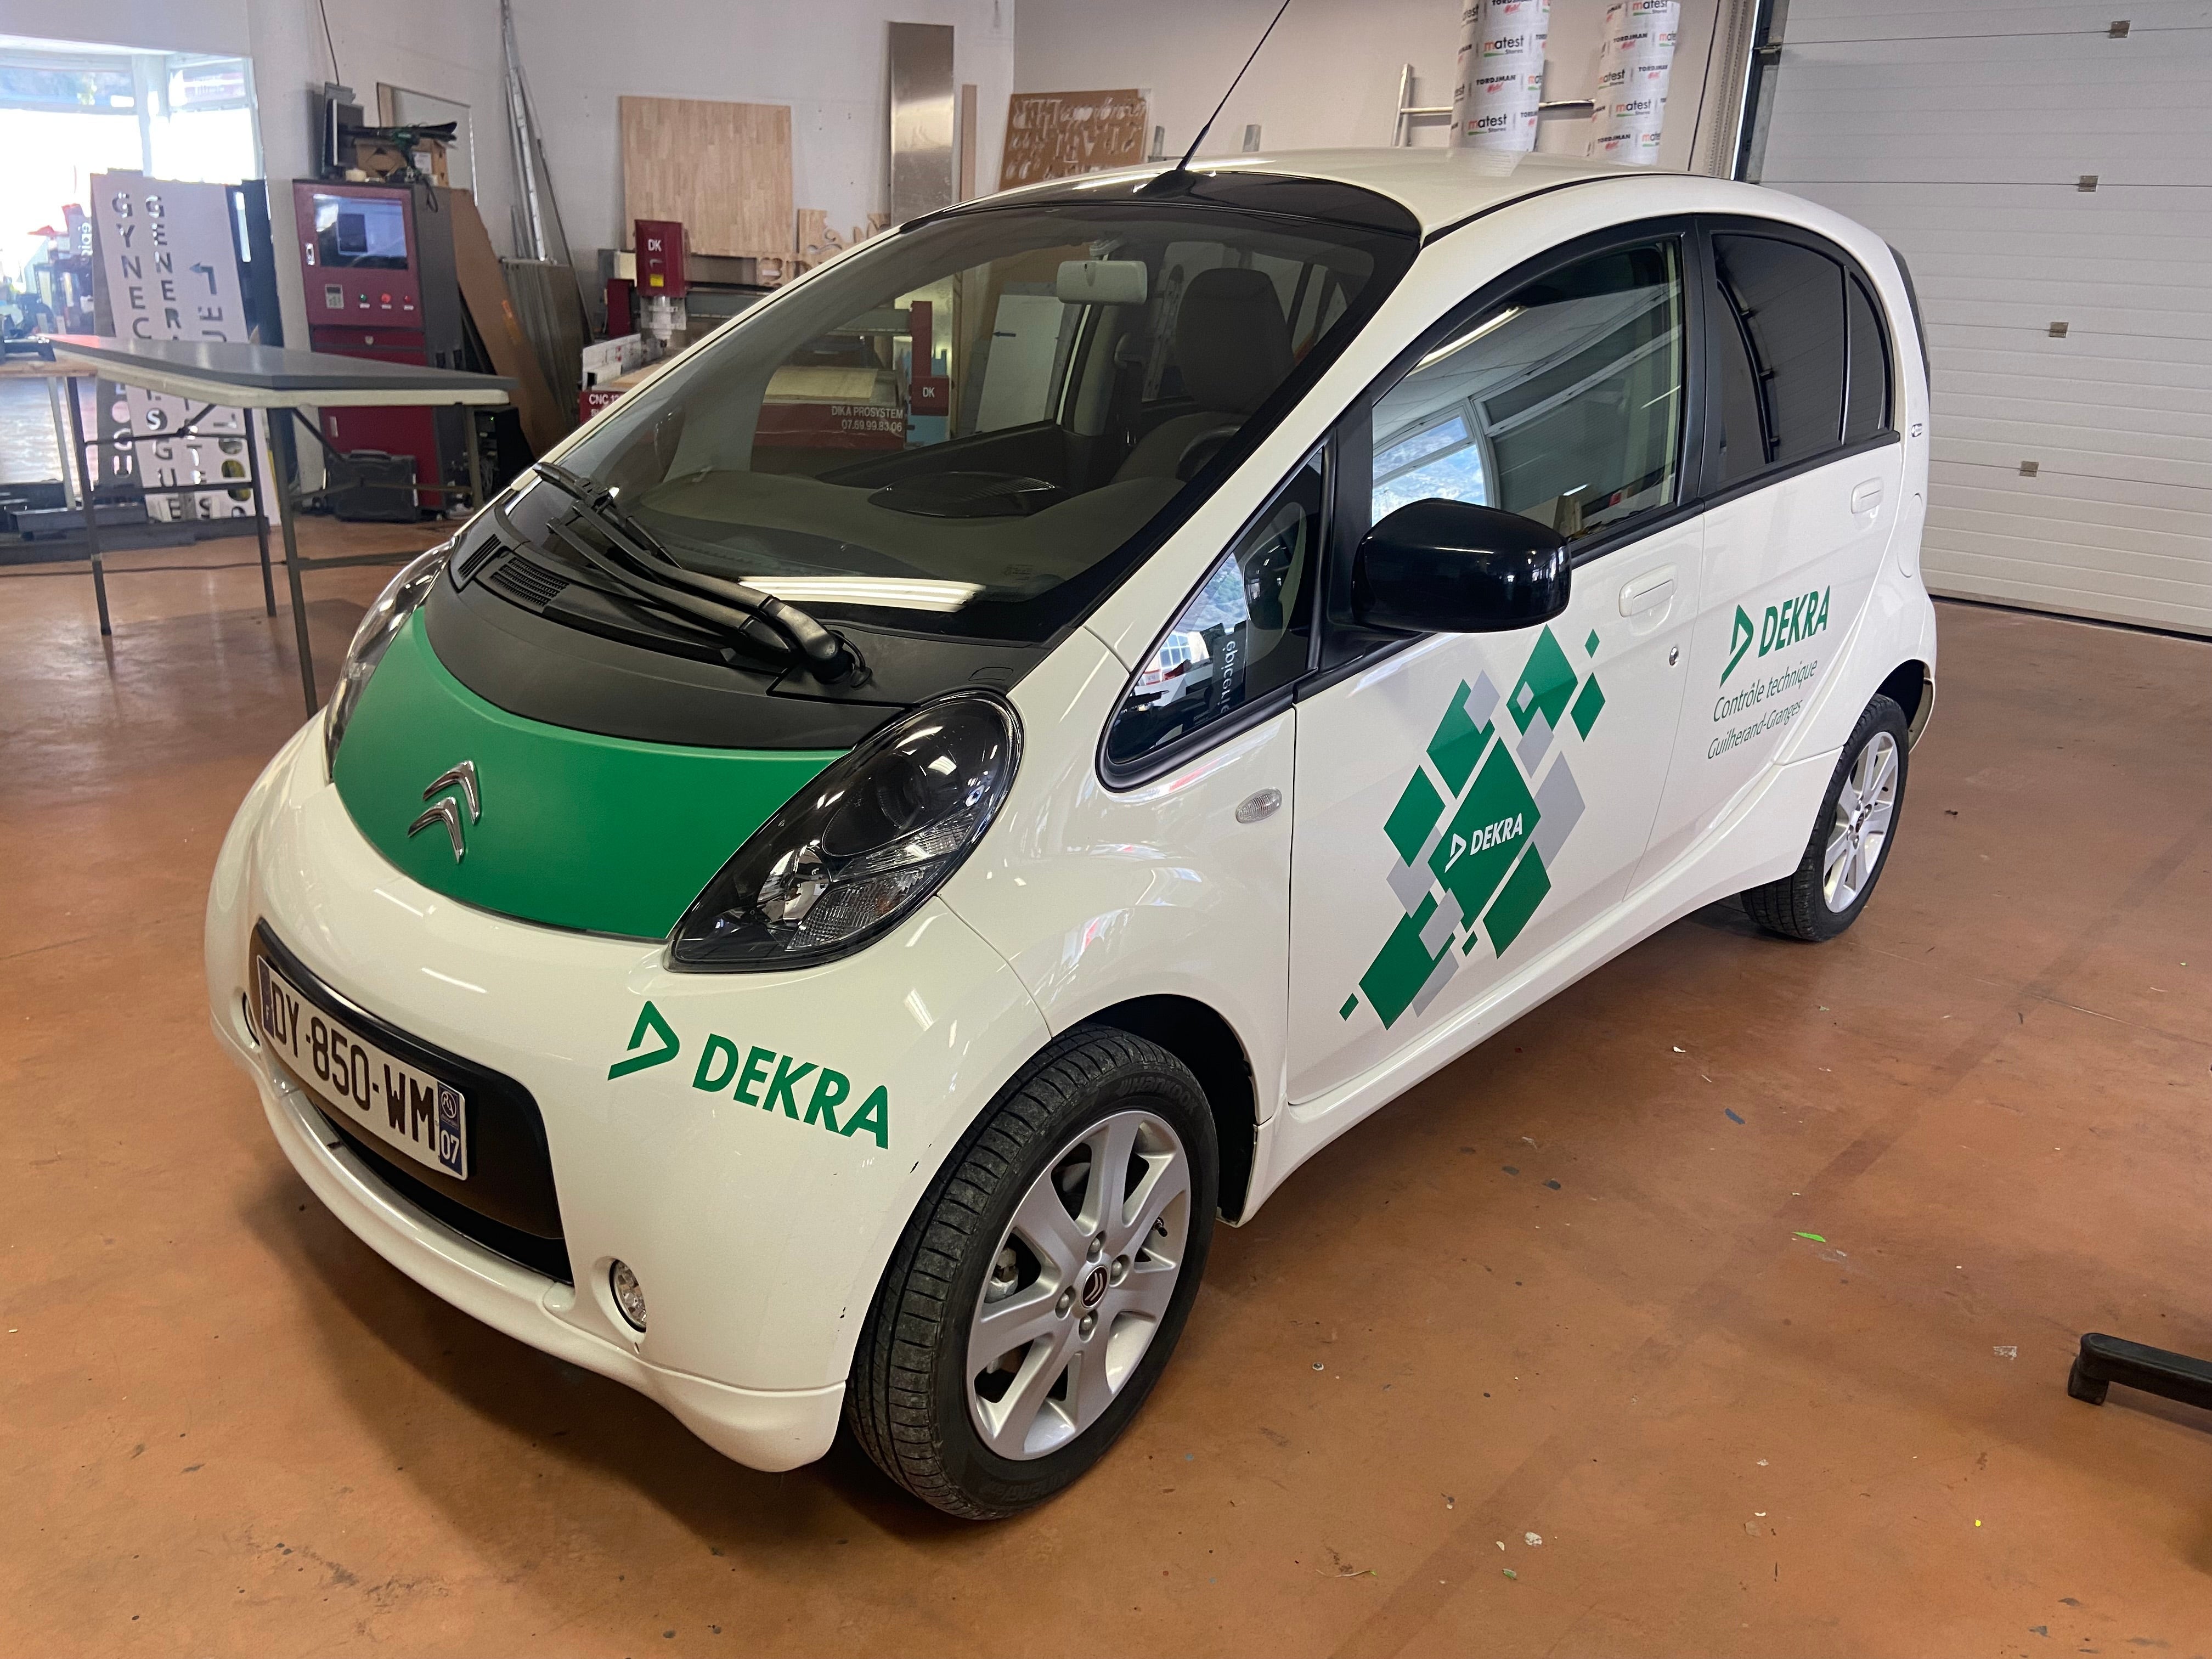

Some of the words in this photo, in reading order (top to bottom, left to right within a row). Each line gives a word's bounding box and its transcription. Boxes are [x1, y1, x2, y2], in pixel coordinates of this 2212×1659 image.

[1484, 35, 1524, 50] matest
[1476, 75, 1516, 86] TORDJMAN
[1616, 99, 1651, 112] matest
[1468, 114, 1508, 129] matest
[647, 239, 662, 252] DK
[589, 393, 609, 405] CNC
[922, 387, 935, 398] DK
[831, 406, 851, 416] DIKA
[854, 407, 904, 419] PROSYSTEM
[1758, 585, 1831, 658] DEKRA
[1713, 678, 1765, 723] Contrôle
[1766, 659, 1818, 698] technique
[1707, 699, 1803, 760] Guilherand-Granges
[1470, 812, 1523, 856] DEKRA
[692, 1032, 889, 1149] DEKRA
[441, 1129, 460, 1164] 07
